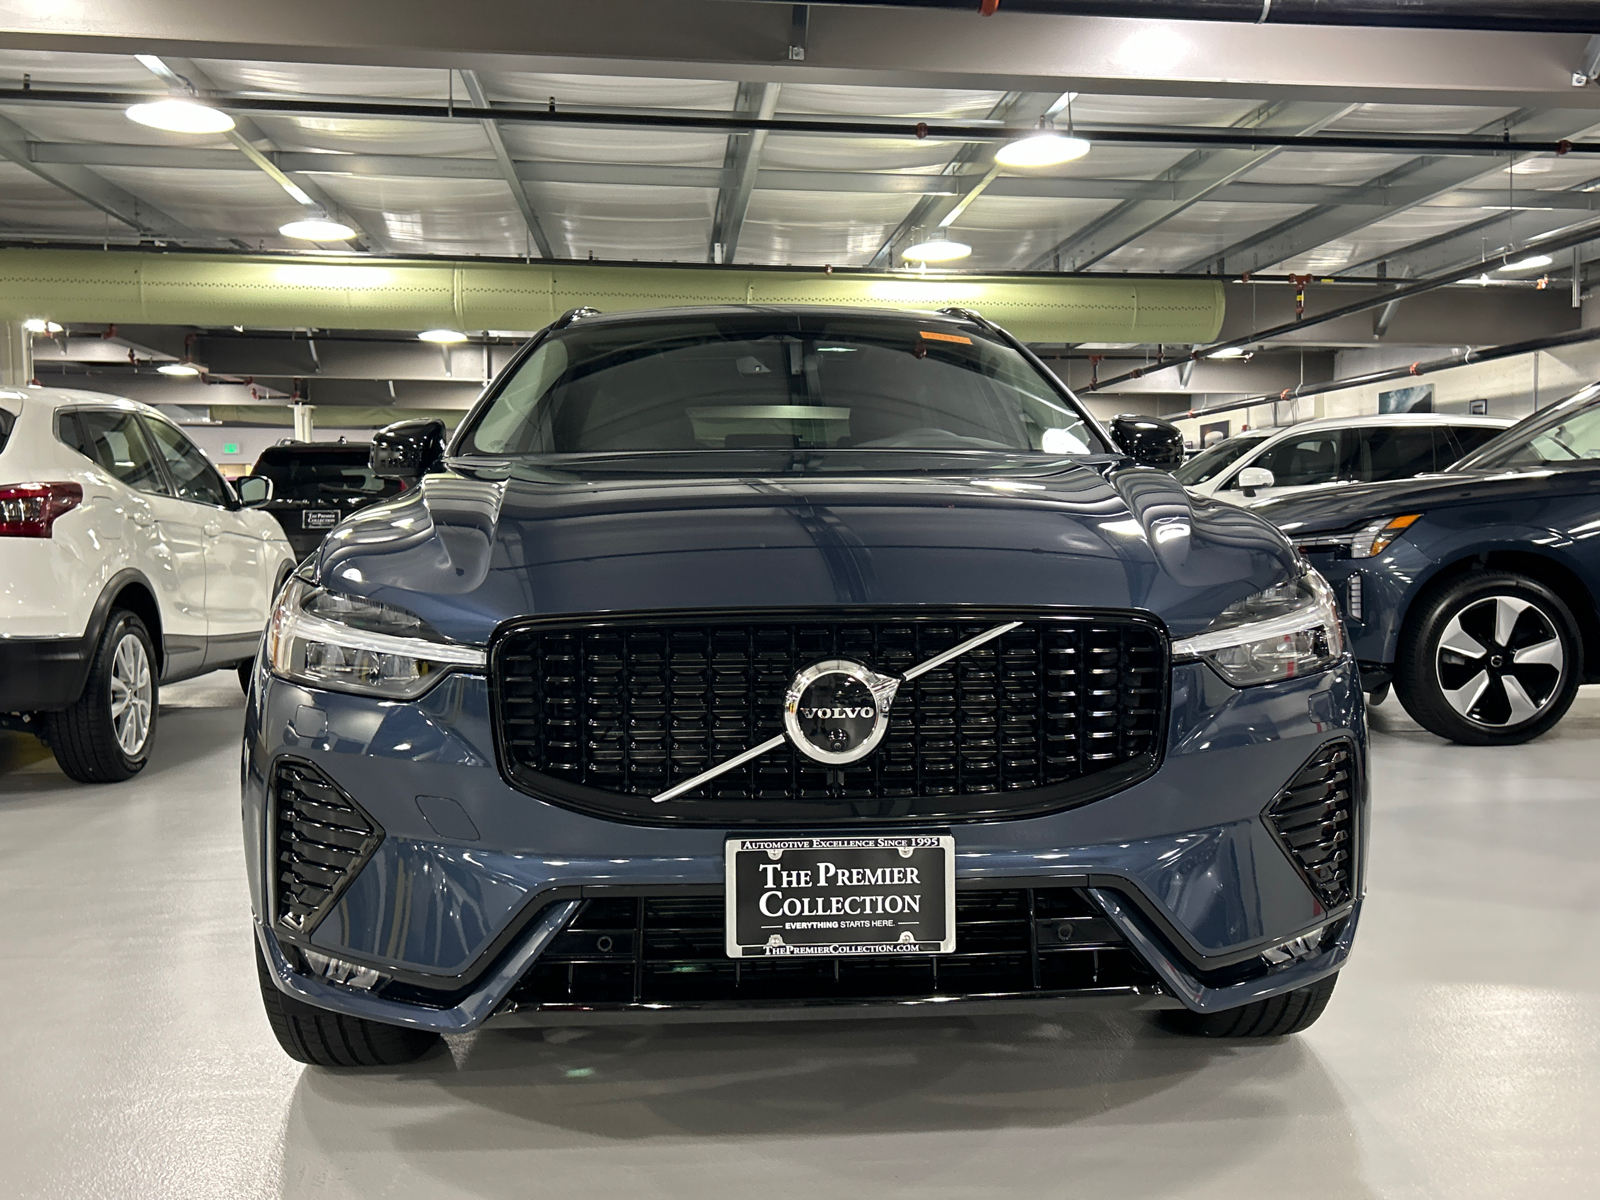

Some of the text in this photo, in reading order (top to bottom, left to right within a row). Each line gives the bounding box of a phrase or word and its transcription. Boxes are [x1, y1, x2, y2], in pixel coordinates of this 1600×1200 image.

[800, 707, 875, 719] VOLVO
[743, 837, 939, 850] AUTOMOTIVE EXCELLENCE SINCE 1995
[759, 862, 921, 888] THE PREMIER
[759, 890, 921, 917] COLLECTION
[785, 919, 896, 930] EVERYTHING STARTS HERE.
[763, 943, 920, 956] THEPREMIERCOLLECTION.COM
